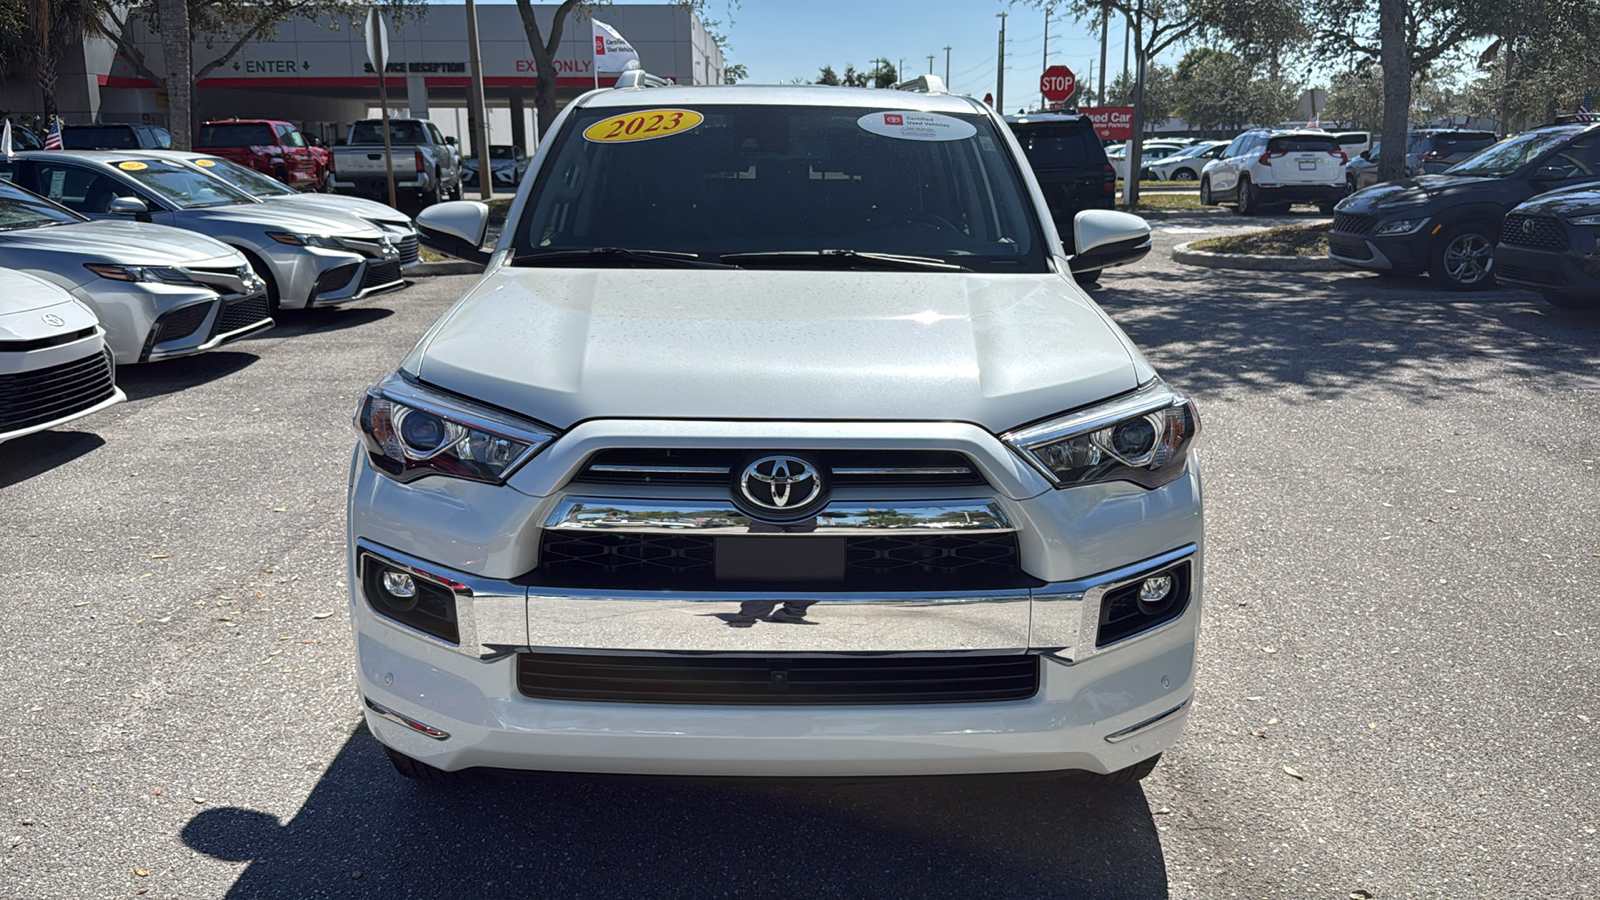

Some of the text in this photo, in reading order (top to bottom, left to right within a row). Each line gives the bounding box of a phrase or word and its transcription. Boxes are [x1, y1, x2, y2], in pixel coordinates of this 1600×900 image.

[246, 60, 297, 72] ENTER
[408, 62, 465, 73] RECEPTION
[1042, 76, 1072, 91] STOP
[1081, 112, 1131, 122] sed Car
[604, 112, 684, 139] 2023
